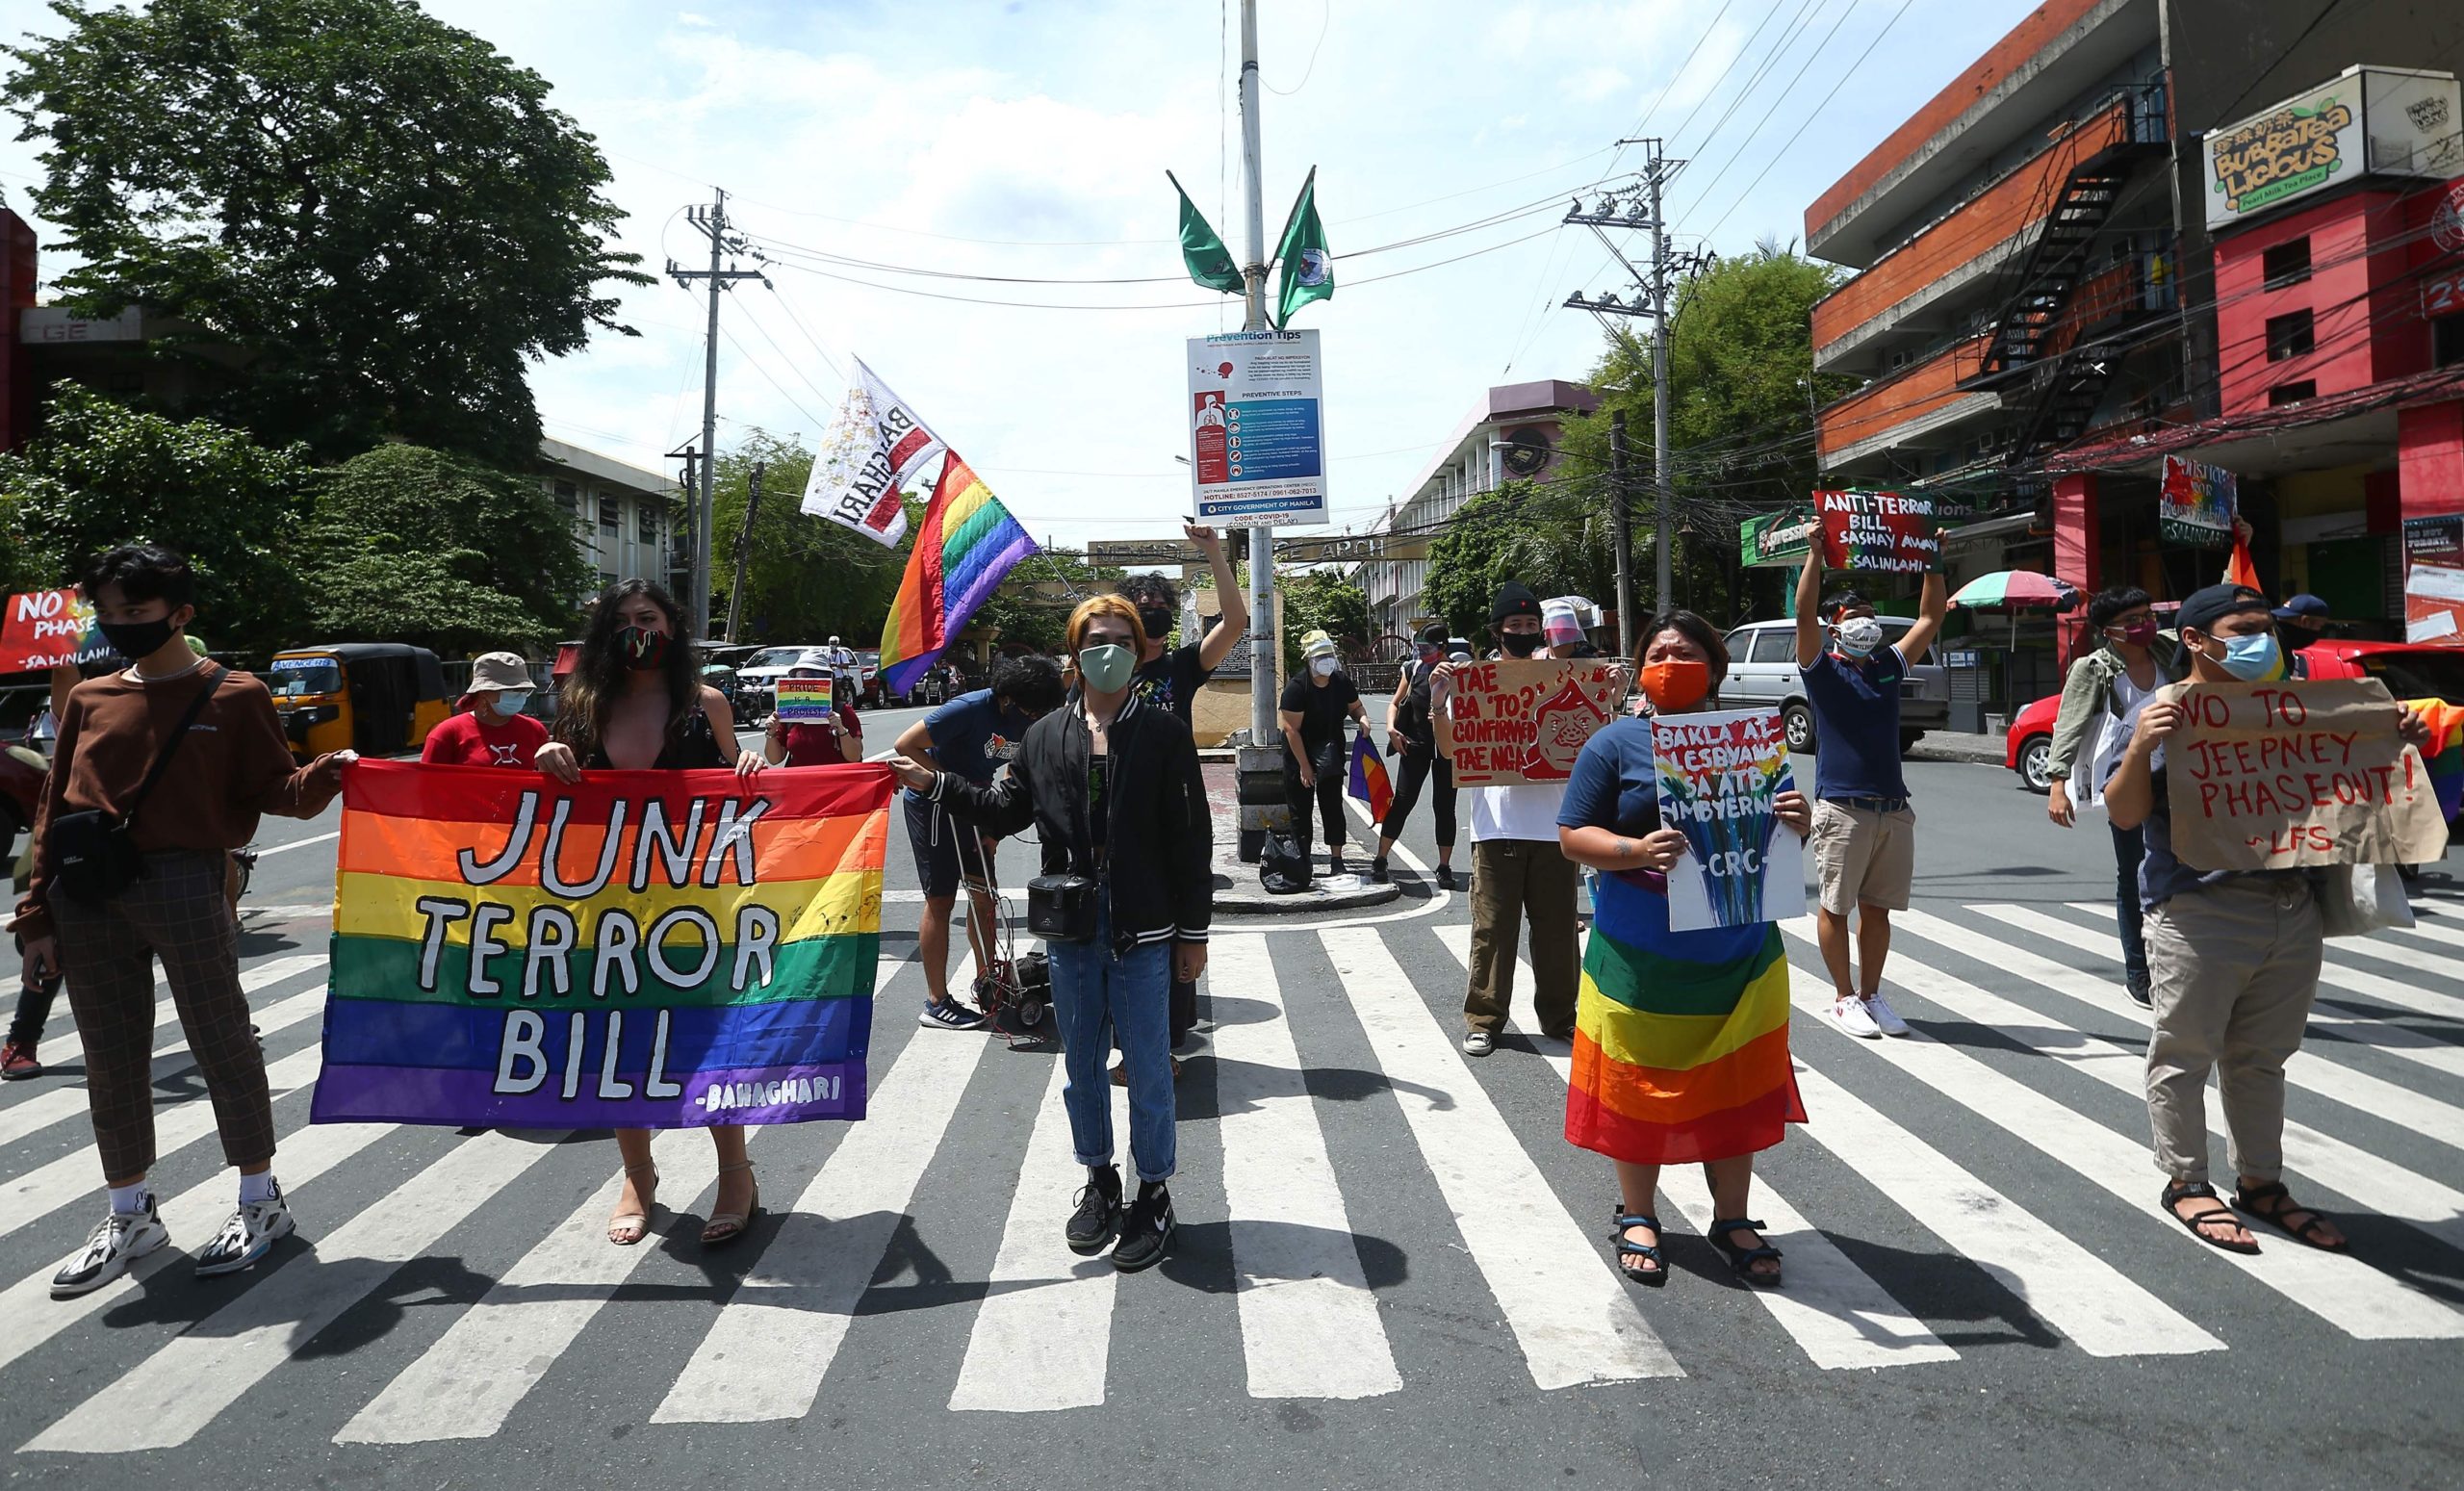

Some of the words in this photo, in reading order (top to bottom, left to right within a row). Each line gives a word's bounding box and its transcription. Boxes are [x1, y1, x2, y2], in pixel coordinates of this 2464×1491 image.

[1207, 330, 1271, 343] Prevention
[1276, 331, 1301, 341] Tips
[1824, 493, 1934, 516] ANTI-TERROR
[1849, 514, 1892, 532] BILL,
[1318, 539, 1384, 558] ARCH
[1838, 530, 1896, 549] SASHAY
[1901, 531, 1938, 552] AWAY
[18, 591, 64, 622] NO
[273, 658, 332, 671] AVENGERS
[788, 682, 818, 692] PRIDE
[1450, 663, 1500, 694] TAE
[787, 707, 821, 716] PROTEST
[1453, 695, 1480, 720] BA
[2180, 691, 2230, 728] NO
[2250, 689, 2307, 728] TO
[1452, 719, 1538, 744] CONFIRMED
[1657, 725, 1732, 750] BAKLA
[1452, 746, 1490, 770] TAE
[1491, 744, 1526, 772] NGA
[2187, 731, 2357, 781] JEEPNEY
[1684, 774, 1712, 799] SA
[1718, 766, 1766, 797] ATB
[457, 790, 771, 900] JUNK
[415, 895, 783, 1000] TERROR
[492, 1008, 683, 1102] BILL
